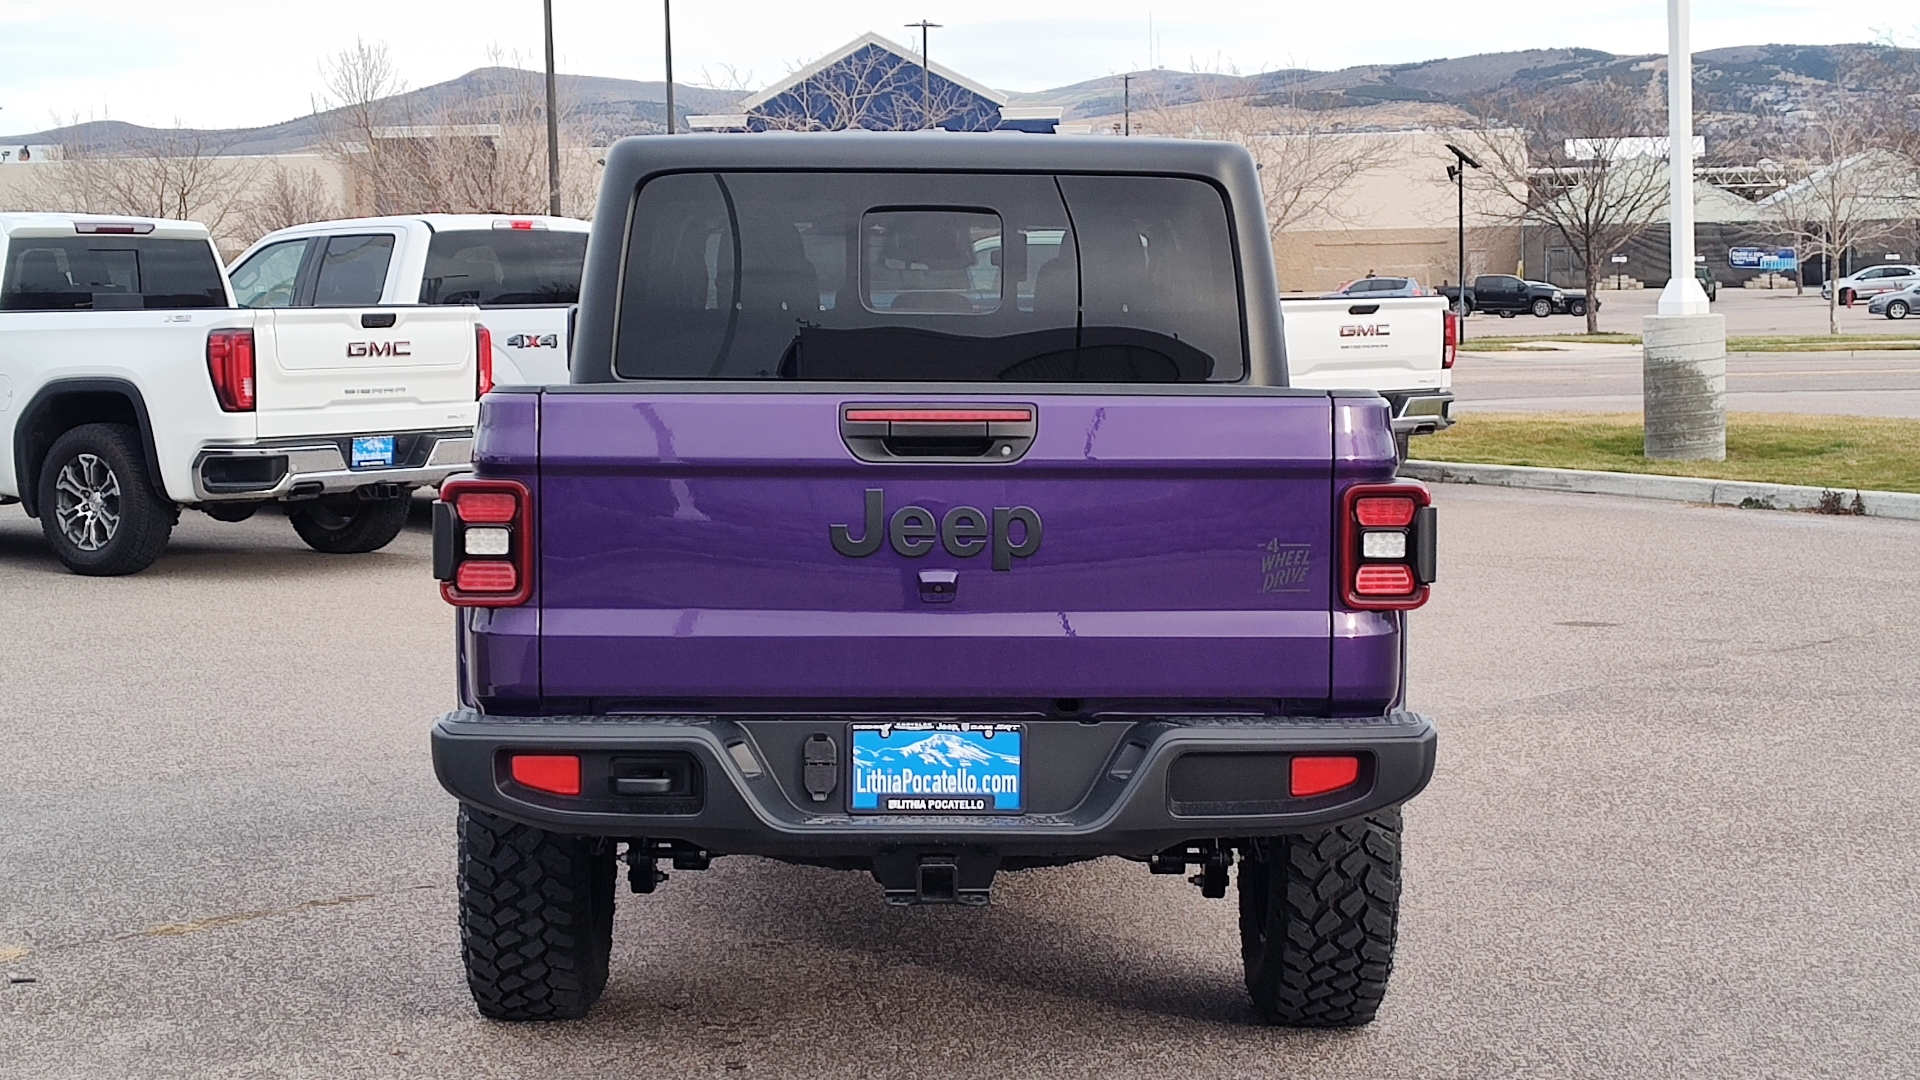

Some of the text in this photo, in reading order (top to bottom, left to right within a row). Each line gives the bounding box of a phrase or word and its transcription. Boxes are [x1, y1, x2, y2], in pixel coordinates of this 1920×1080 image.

[1339, 324, 1390, 337] GMC
[346, 341, 411, 358] GMC
[829, 488, 1043, 572] Jeep
[1266, 537, 1280, 553] 4
[1261, 550, 1310, 573] WHEEL
[1261, 567, 1310, 594] DRIVE
[856, 768, 1018, 793] LithiaPocatello.com
[928, 799, 985, 810] POCATELLO
